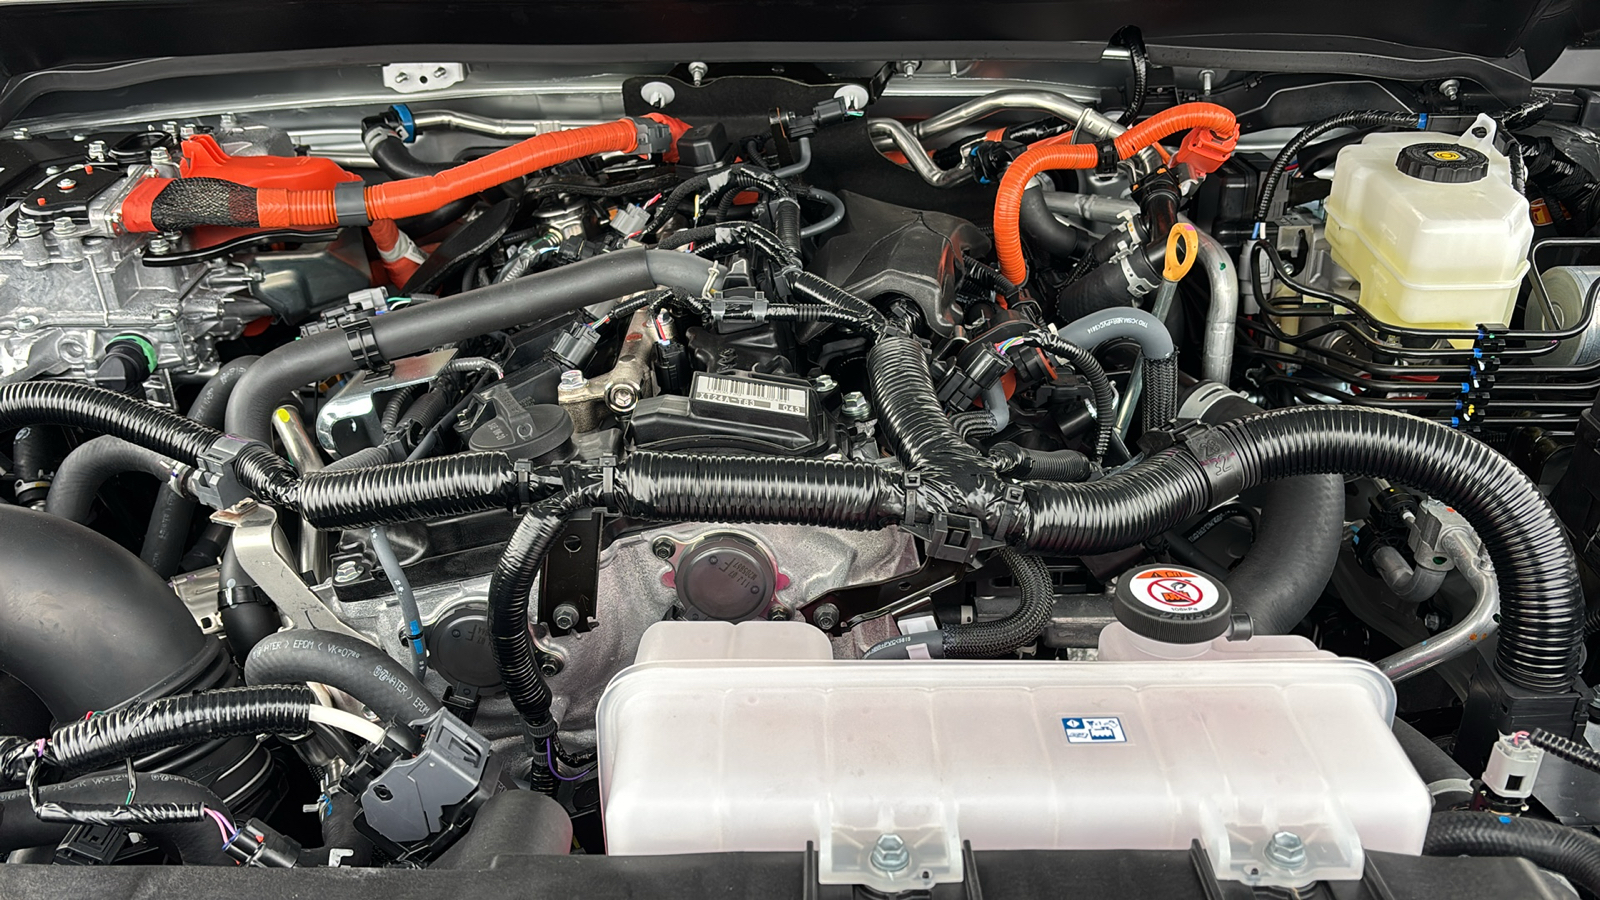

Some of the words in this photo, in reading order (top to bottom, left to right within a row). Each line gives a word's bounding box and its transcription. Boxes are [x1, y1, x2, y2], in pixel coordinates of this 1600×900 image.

[700, 392, 755, 407] XT24A-T83
[782, 404, 801, 414] 043
[293, 639, 314, 649] EPDM
[387, 673, 410, 695] WATER
[412, 697, 431, 716] EPDM
